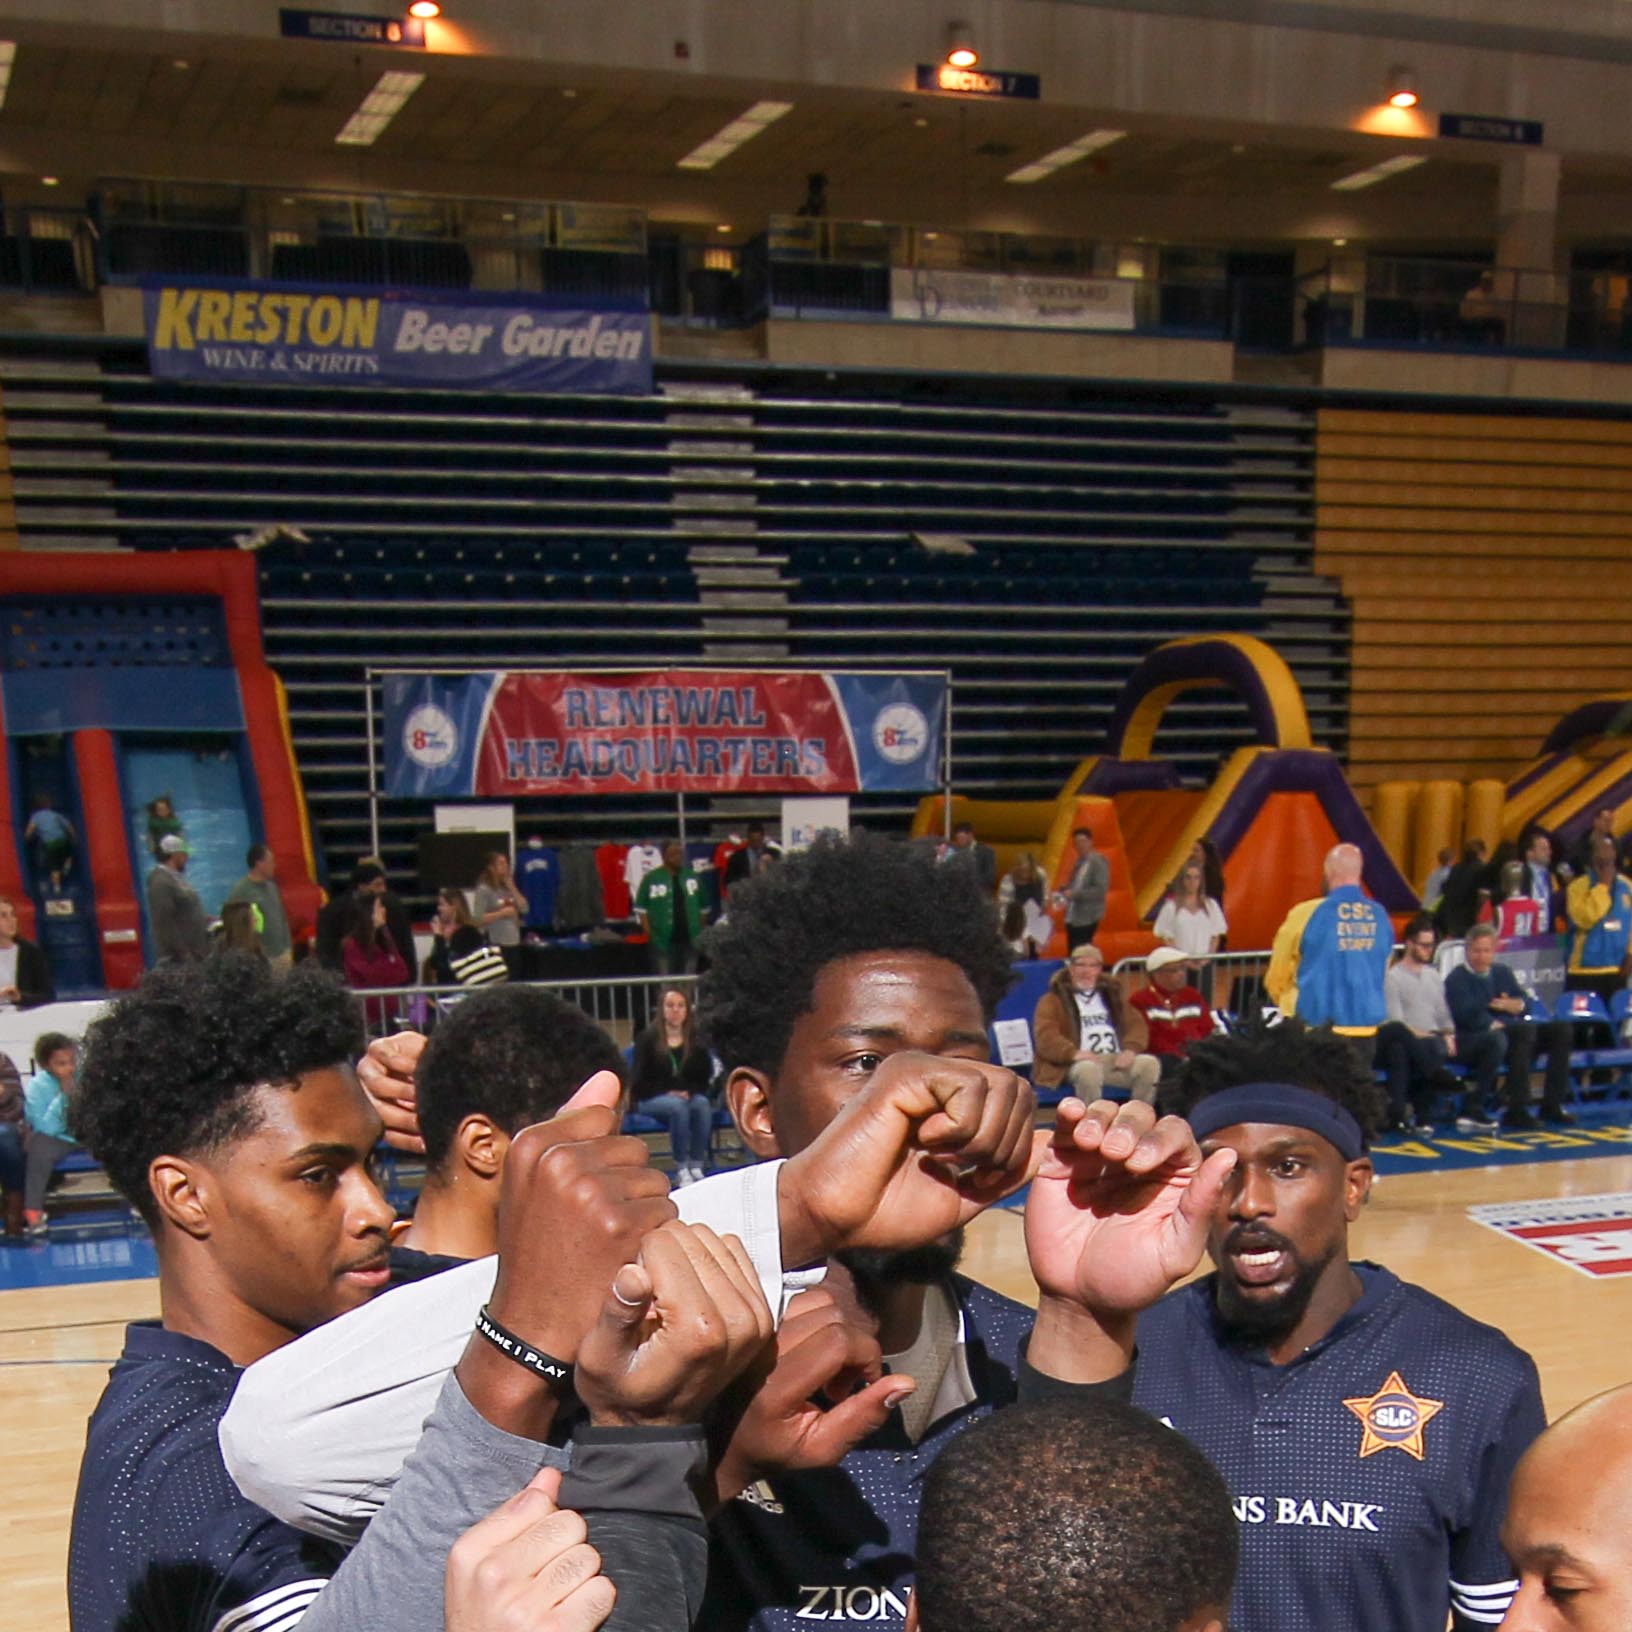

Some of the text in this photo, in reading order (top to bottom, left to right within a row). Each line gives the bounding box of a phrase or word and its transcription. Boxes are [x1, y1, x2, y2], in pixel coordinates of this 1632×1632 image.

[154, 287, 381, 350] KRESTON
[395, 309, 644, 360] Beer Garden
[202, 347, 380, 375] WINE & SPIRITS
[565, 687, 767, 728] RENEWAL
[506, 737, 827, 780] HEADQUARTERS
[1087, 1032, 1116, 1054] 23
[482, 1321, 567, 1378] NAME I PLAY
[1375, 1406, 1414, 1428] SLC
[1275, 1497, 1381, 1532] BANK
[795, 1584, 912, 1621] ZION
